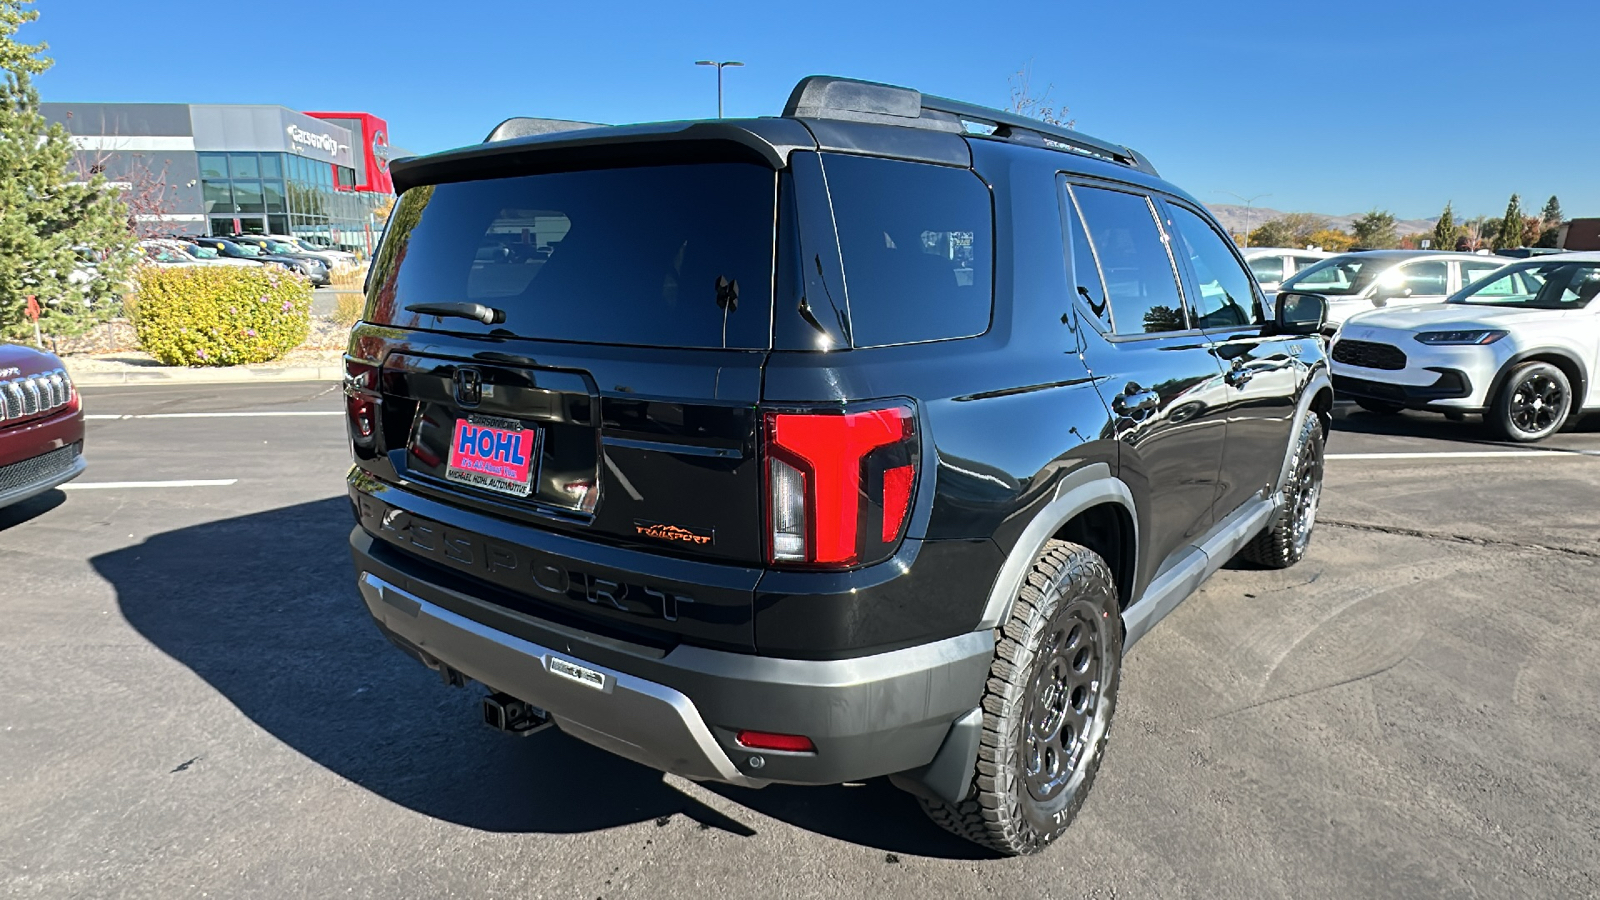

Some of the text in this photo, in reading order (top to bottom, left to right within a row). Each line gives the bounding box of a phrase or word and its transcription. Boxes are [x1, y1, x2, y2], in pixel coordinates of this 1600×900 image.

[459, 426, 525, 466] HOHL
[484, 462, 502, 475] About
[449, 470, 527, 494] MICHAEL HOHL AUTOMOTIVE
[636, 526, 711, 544] TRAILSPORT
